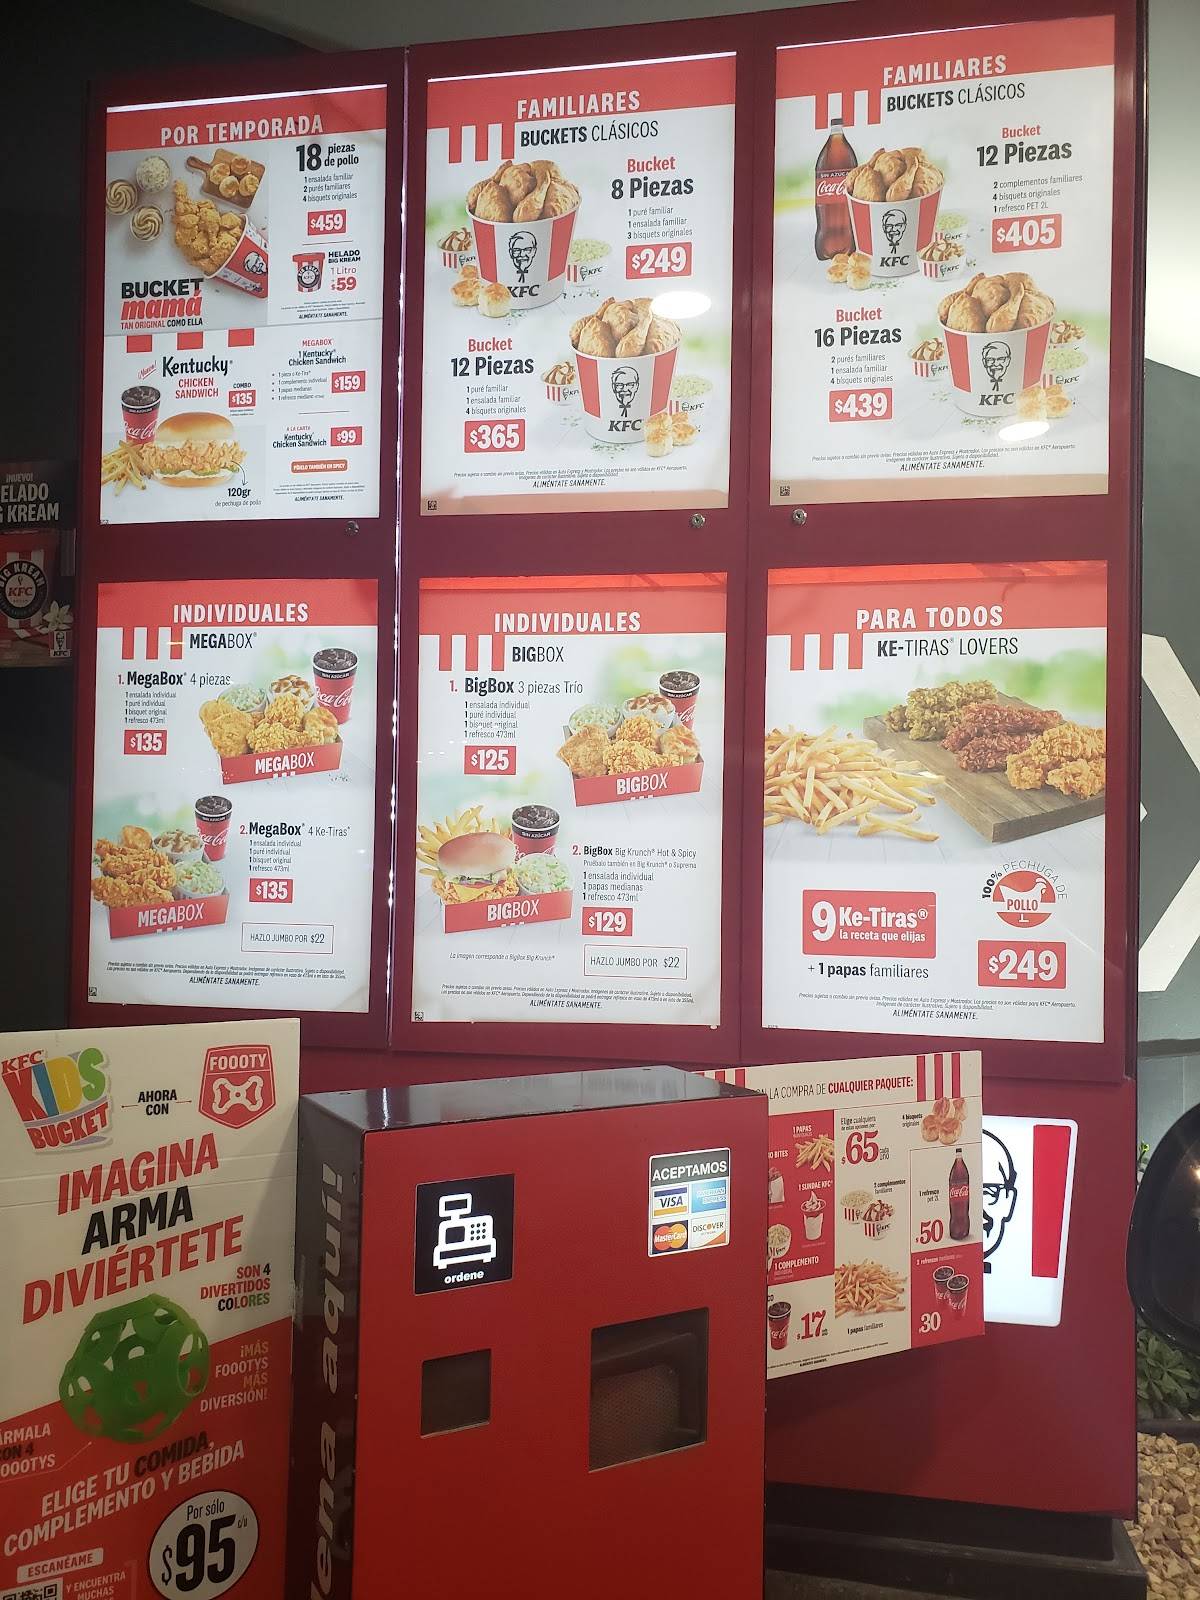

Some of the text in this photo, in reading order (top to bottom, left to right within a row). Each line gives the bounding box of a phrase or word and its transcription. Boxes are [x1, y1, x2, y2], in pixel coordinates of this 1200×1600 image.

[883, 54, 1007, 86] FAMILIARES
[518, 90, 641, 119] FAMILIARES
[887, 82, 1025, 112] BUCKETS CLÁSICOS
[161, 114, 324, 146] POR TEMPORADA
[521, 120, 658, 147] BUCKETS CLÁSICOS
[296, 144, 355, 172] 18 piezas
[324, 154, 359, 167] de pollo
[977, 142, 1072, 167] 12 Piezas
[611, 178, 693, 200] 8 Piezas
[999, 178, 1048, 190] complementos
[1049, 174, 1083, 184] familiares
[310, 214, 343, 231] $459
[996, 218, 1056, 247] $405
[329, 250, 360, 258] HELADO
[632, 247, 686, 274] $249
[122, 278, 204, 298] BUCKET
[331, 276, 356, 291] $59
[122, 290, 202, 320] mamá
[122, 318, 203, 329] TAN ORIGINAL COMO ELLA
[814, 327, 902, 348] 16 Piezas
[289, 356, 346, 366] Chicken Sandwich
[451, 357, 534, 377] 12 Piezas
[178, 377, 214, 388] CHICKEN
[334, 375, 360, 390] $159
[176, 388, 218, 398] SANDWICH
[232, 393, 252, 404] $135
[979, 392, 1014, 406] KFC
[835, 392, 887, 417] $439
[337, 430, 356, 443] $99
[470, 424, 520, 449] $365
[900, 460, 985, 472] ALIMÉNTATE SANAMENTE.
[228, 487, 251, 498] 120gr
[8, 587, 33, 597] KFC
[174, 603, 308, 624] INDIVIDUALES
[857, 605, 1004, 630] PARA TODOS
[512, 646, 564, 662] BIGBOX
[959, 638, 1019, 655] LOVERS
[118, 674, 124, 685] 1.
[191, 674, 196, 685] 4
[200, 674, 231, 687] piezas
[450, 678, 583, 696] 1. BigBox 3 piezas Trío
[256, 752, 314, 775] MEGABOX
[472, 750, 509, 771] $125
[573, 845, 581, 856] 2.
[584, 846, 612, 857] BigBox
[615, 847, 626, 857] Big
[657, 848, 668, 856] Hot
[678, 849, 696, 858] Spicy
[588, 872, 618, 880] ensalada
[620, 872, 654, 881] individual
[982, 859, 1068, 900] 100% PECHUGA DE
[256, 881, 288, 899] $135
[588, 884, 609, 892] papas
[610, 883, 643, 891] medianas
[1007, 899, 1038, 911] POLLO
[589, 911, 626, 932] $129
[812, 900, 836, 942] 9
[840, 930, 926, 943] la receta que elijas
[591, 956, 680, 968] HAZLO JUMBO POR $22
[818, 963, 824, 974] 1
[828, 964, 866, 977] papas
[870, 964, 929, 979] familiares
[988, 949, 1058, 980] $249
[893, 1009, 978, 1020] ALIMÉNTATE SANAMENTE.
[2, 1051, 43, 1074] KFC
[210, 1054, 266, 1070] FOOOTY
[2, 1048, 106, 1122] KIDS
[770, 1087, 780, 1099] LA
[781, 1084, 814, 1098] COMPRA
[816, 1083, 826, 1095] DE
[828, 1079, 873, 1094] CUALQUIER
[876, 1077, 913, 1091] PAQUETE:
[138, 1089, 177, 1102] AHORA
[146, 1104, 169, 1115] CON
[27, 1102, 108, 1149] BUCKET
[775, 1150, 788, 1158] BITES
[841, 1130, 878, 1165] $65
[58, 1132, 219, 1216] IMAGINA
[652, 1161, 726, 1181] ACEPTAMOS
[660, 1196, 683, 1208] VISA
[82, 1186, 194, 1255] ARMA
[693, 1222, 723, 1232] DISCOVER
[655, 1232, 687, 1243] MasterCard
[23, 1215, 244, 1324] DIVIÉRTETE
[237, 1263, 271, 1280] SON 4
[444, 1268, 484, 1285] ordene
[201, 1278, 270, 1300] DIVERTIDOS
[218, 1293, 270, 1311] COLORES
[797, 1310, 826, 1340] $17
[851, 1326, 863, 1334] papas
[240, 1341, 268, 1358] ¡MÁS
[216, 1357, 268, 1378] FOOOTYS
[243, 1372, 268, 1386] MÁS
[200, 1389, 267, 1412] DIVERSIÓN!
[4, 1440, 244, 1556] COMPLEMENTO Y BEBIDA
[42, 1476, 97, 1517] ELIGE
[103, 1463, 128, 1485] TU
[187, 1499, 225, 1521] Por sólo
[162, 1514, 247, 1593] $95 c/u
[28, 1552, 93, 1578] ESCANÉAME
